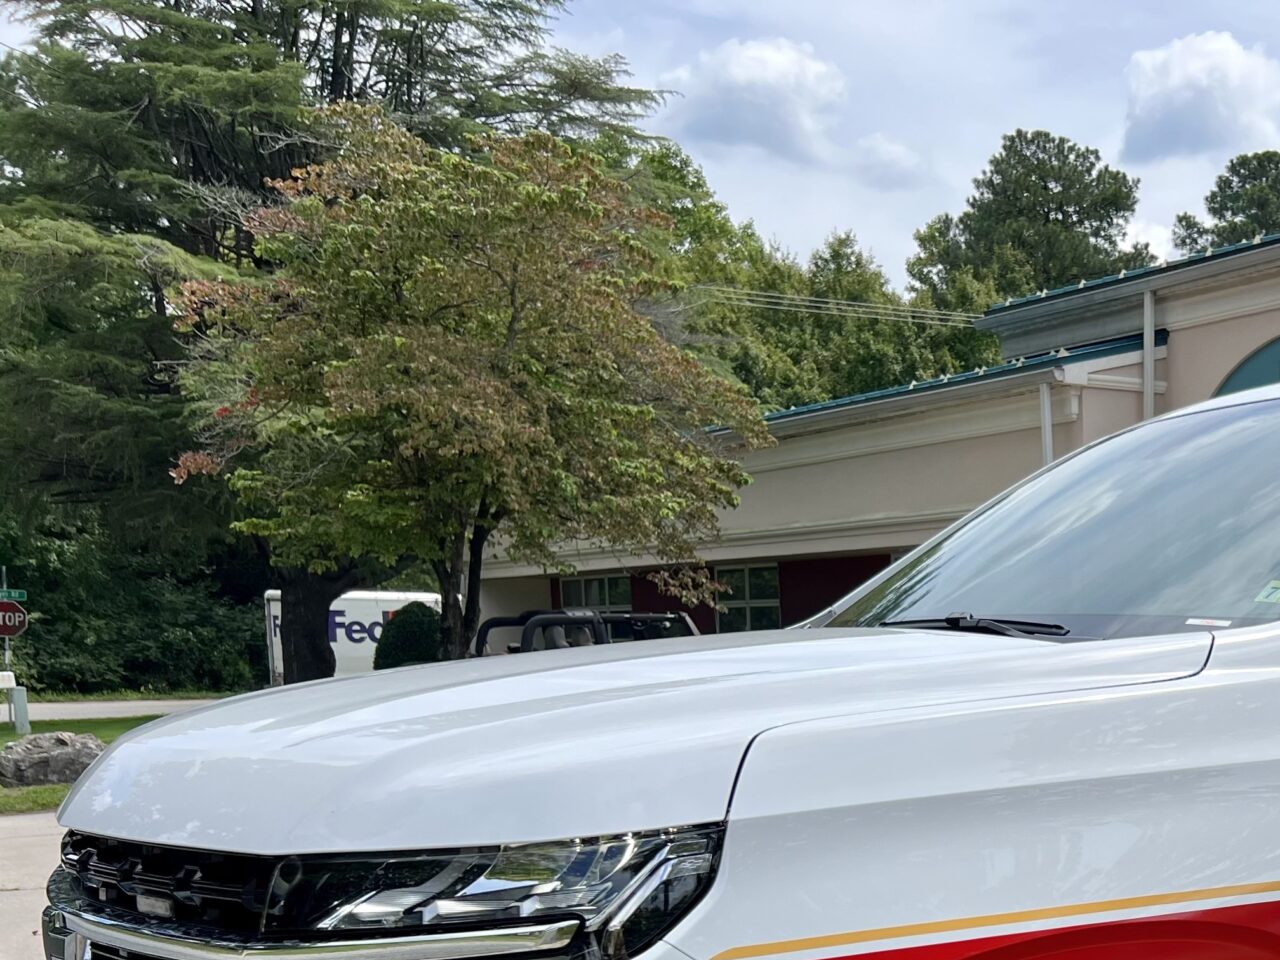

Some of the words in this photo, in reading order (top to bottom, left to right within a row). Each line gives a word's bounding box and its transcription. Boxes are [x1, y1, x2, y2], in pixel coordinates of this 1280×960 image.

[1264, 586, 1280, 599] 7
[0, 612, 24, 626] TOP
[327, 610, 396, 643] Fed
